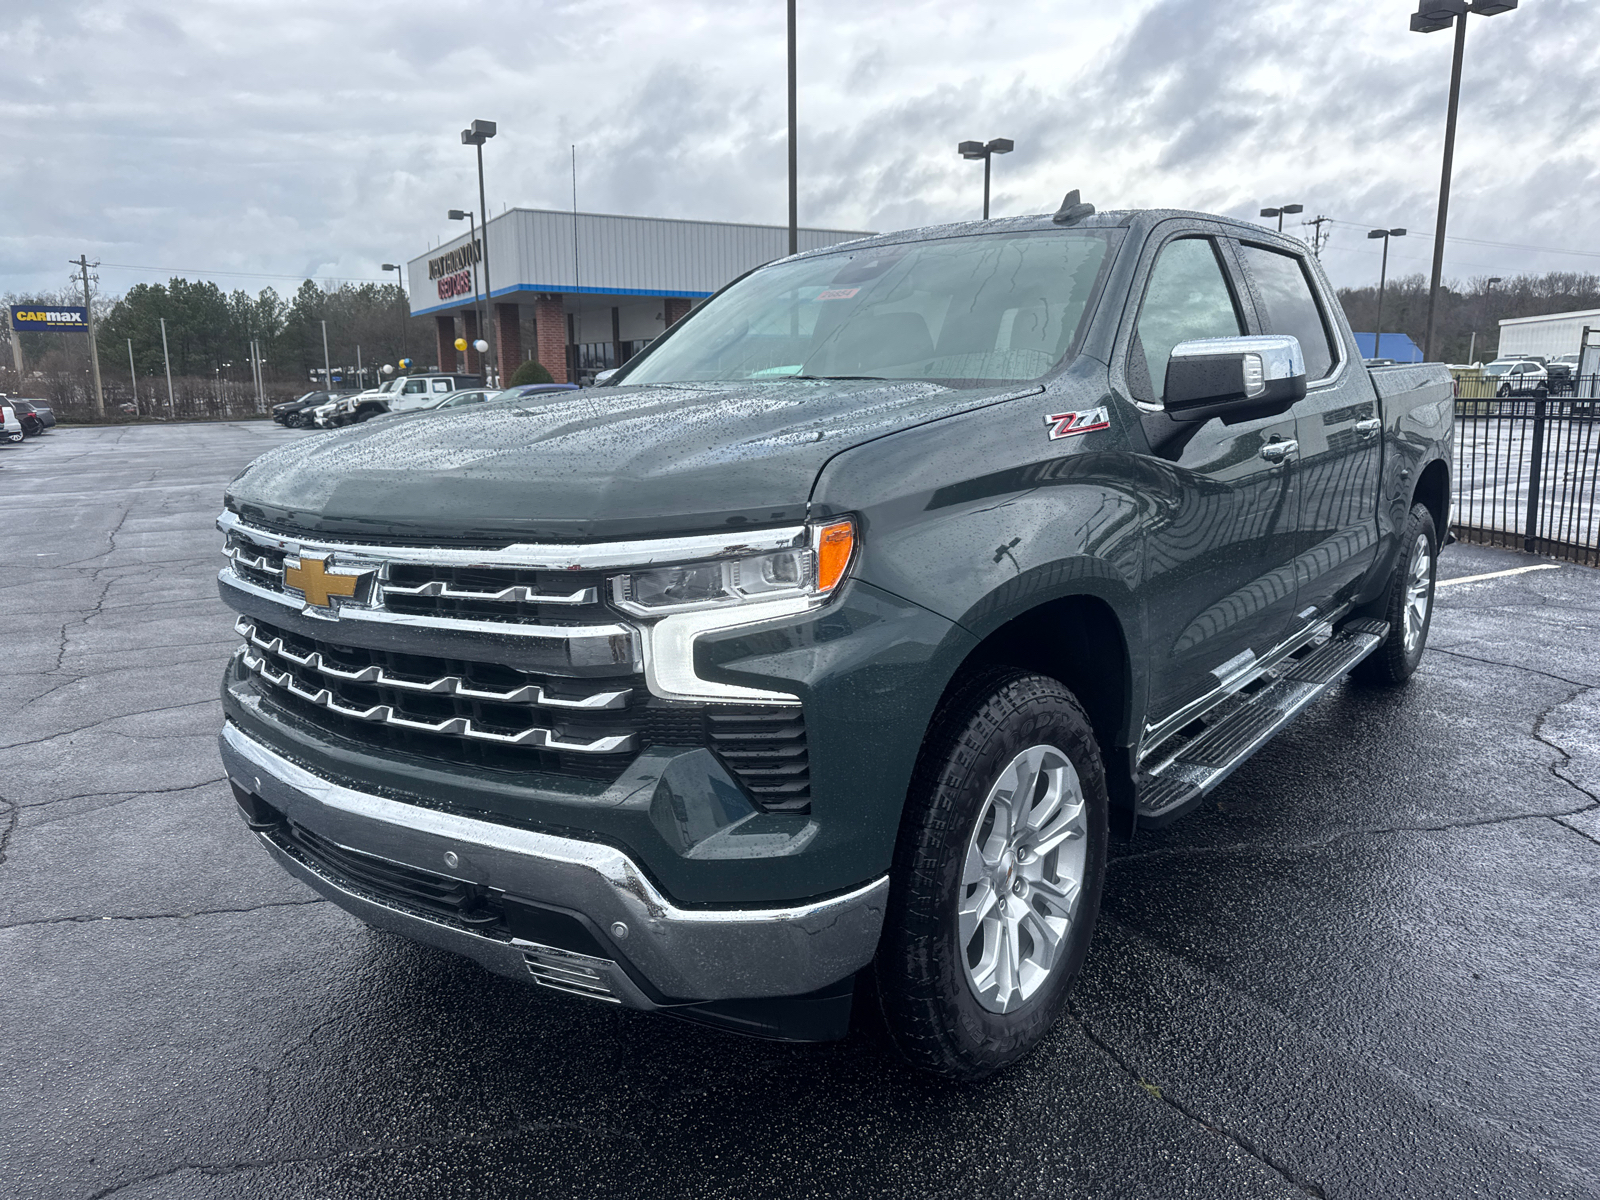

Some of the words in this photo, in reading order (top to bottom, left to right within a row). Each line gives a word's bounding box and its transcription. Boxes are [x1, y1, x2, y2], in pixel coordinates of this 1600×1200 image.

[438, 277, 454, 299] USED
[453, 270, 471, 295] CARS
[1044, 406, 1110, 440] Z71
